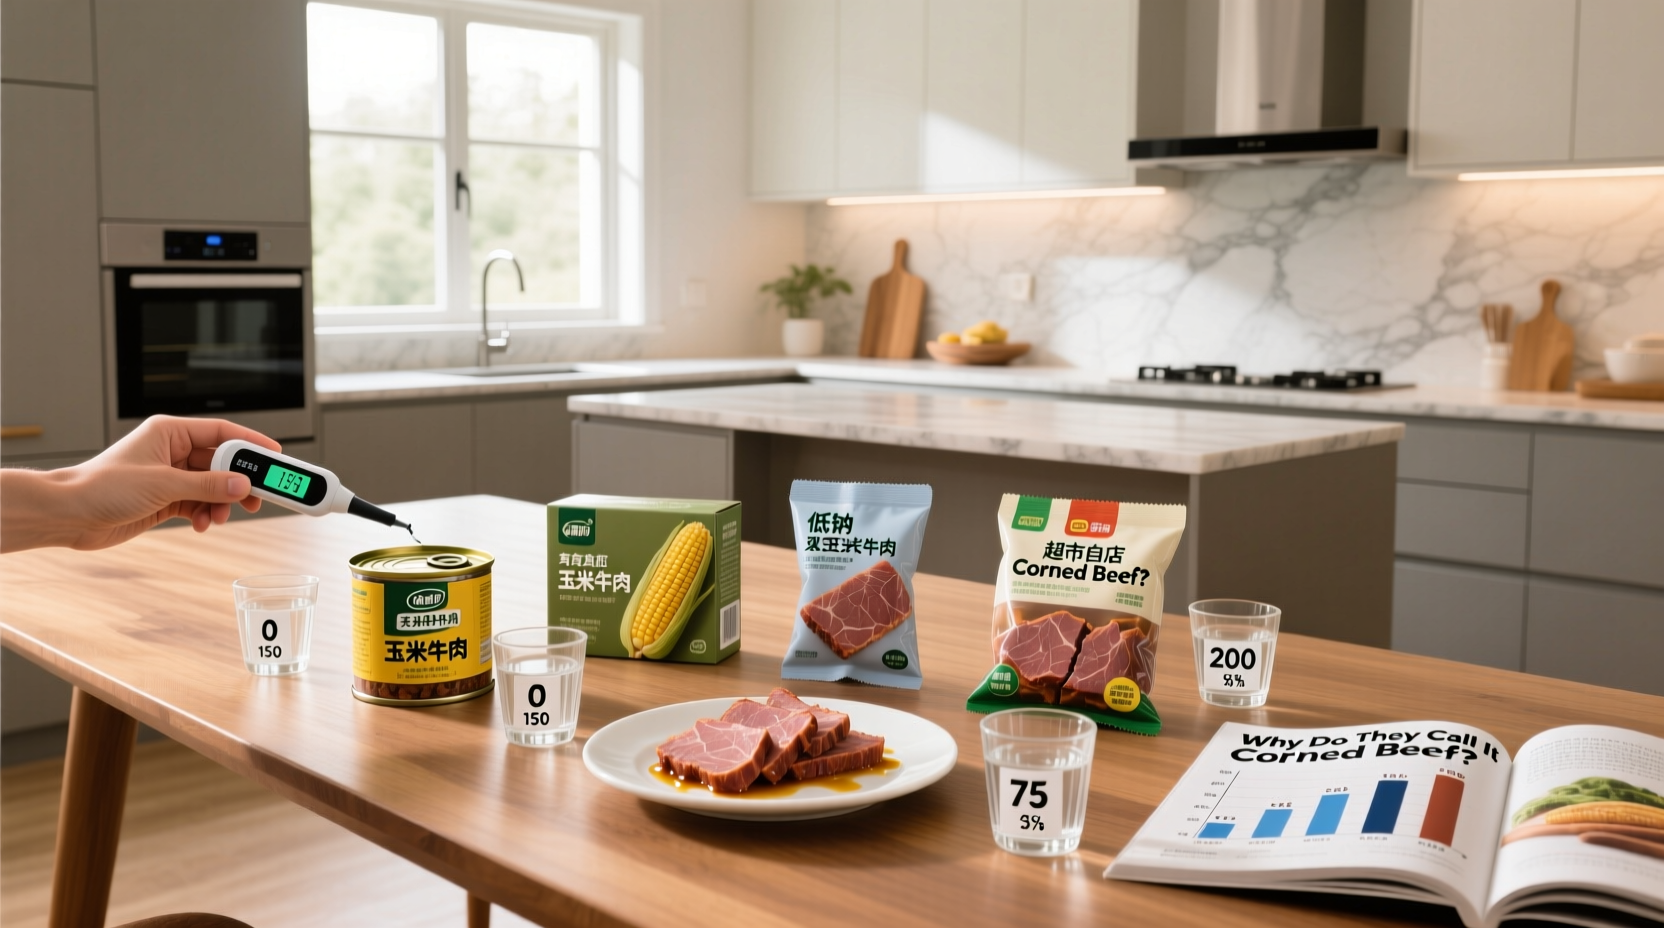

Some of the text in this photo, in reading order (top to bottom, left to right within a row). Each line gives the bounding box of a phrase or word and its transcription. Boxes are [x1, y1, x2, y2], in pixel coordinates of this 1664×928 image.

[1042, 540, 1126, 564] 超市自店
[558, 569, 631, 593] 玉米牛肉
[1012, 558, 1150, 587] Corned Beef?
[261, 619, 278, 642] 0
[258, 645, 282, 658] 150
[384, 636, 468, 663] 玉米牛肉
[1209, 647, 1256, 670] 200
[528, 684, 546, 707] 0
[523, 712, 550, 726] 150
[1231, 743, 1478, 765] Corned Beef?
[1242, 730, 1500, 763] Why Do They Call It
[1010, 779, 1048, 809] 75
